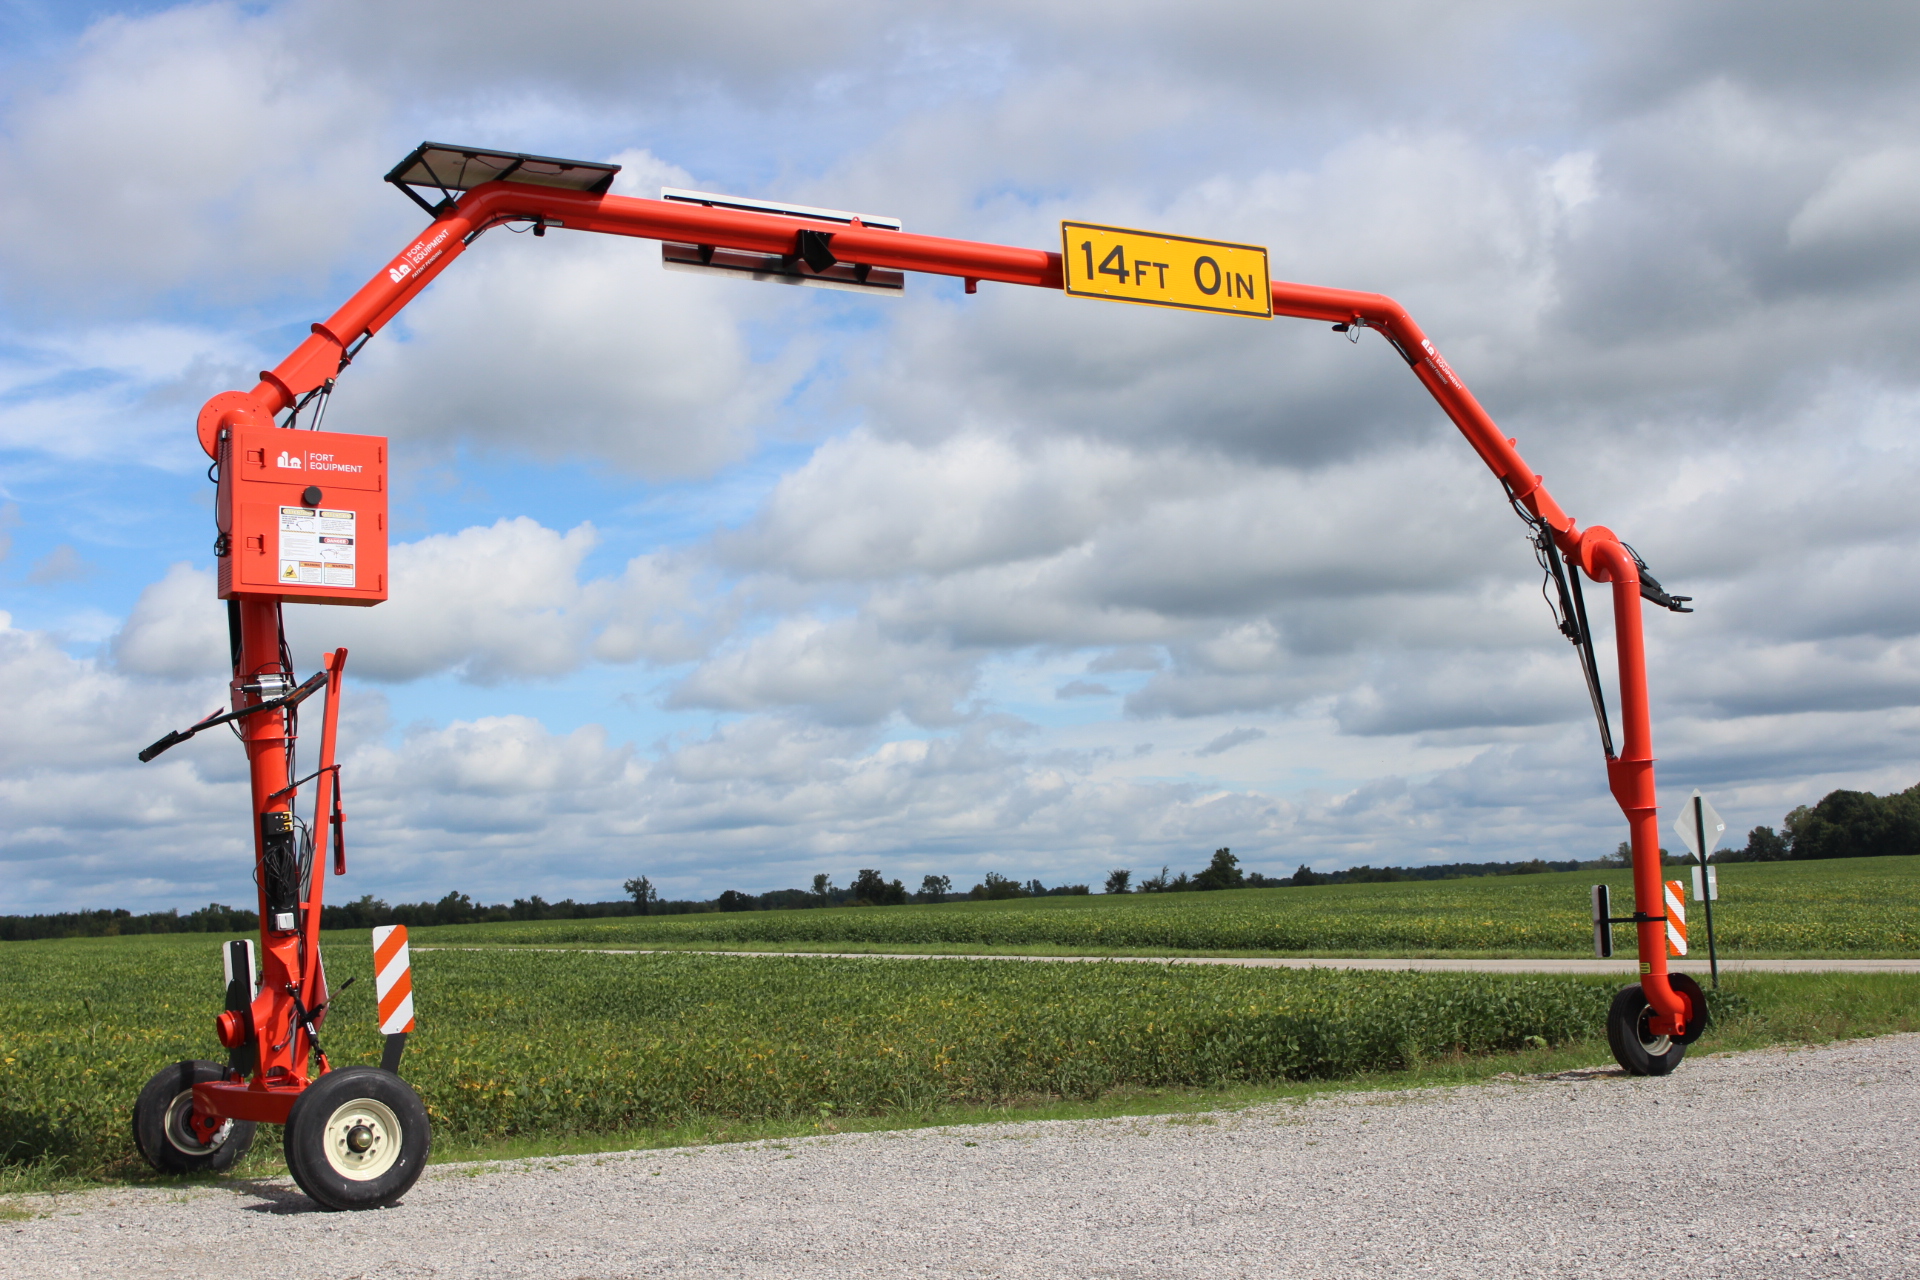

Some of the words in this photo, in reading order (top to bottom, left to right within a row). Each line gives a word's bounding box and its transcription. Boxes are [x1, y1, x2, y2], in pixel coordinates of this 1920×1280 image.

[406, 241, 425, 258] FORT
[413, 229, 449, 264] EQUIPMENT
[1436, 358, 1462, 390] EQUIPMENT
[310, 453, 334, 462] FORT
[310, 461, 363, 473] EQUIPMENT
